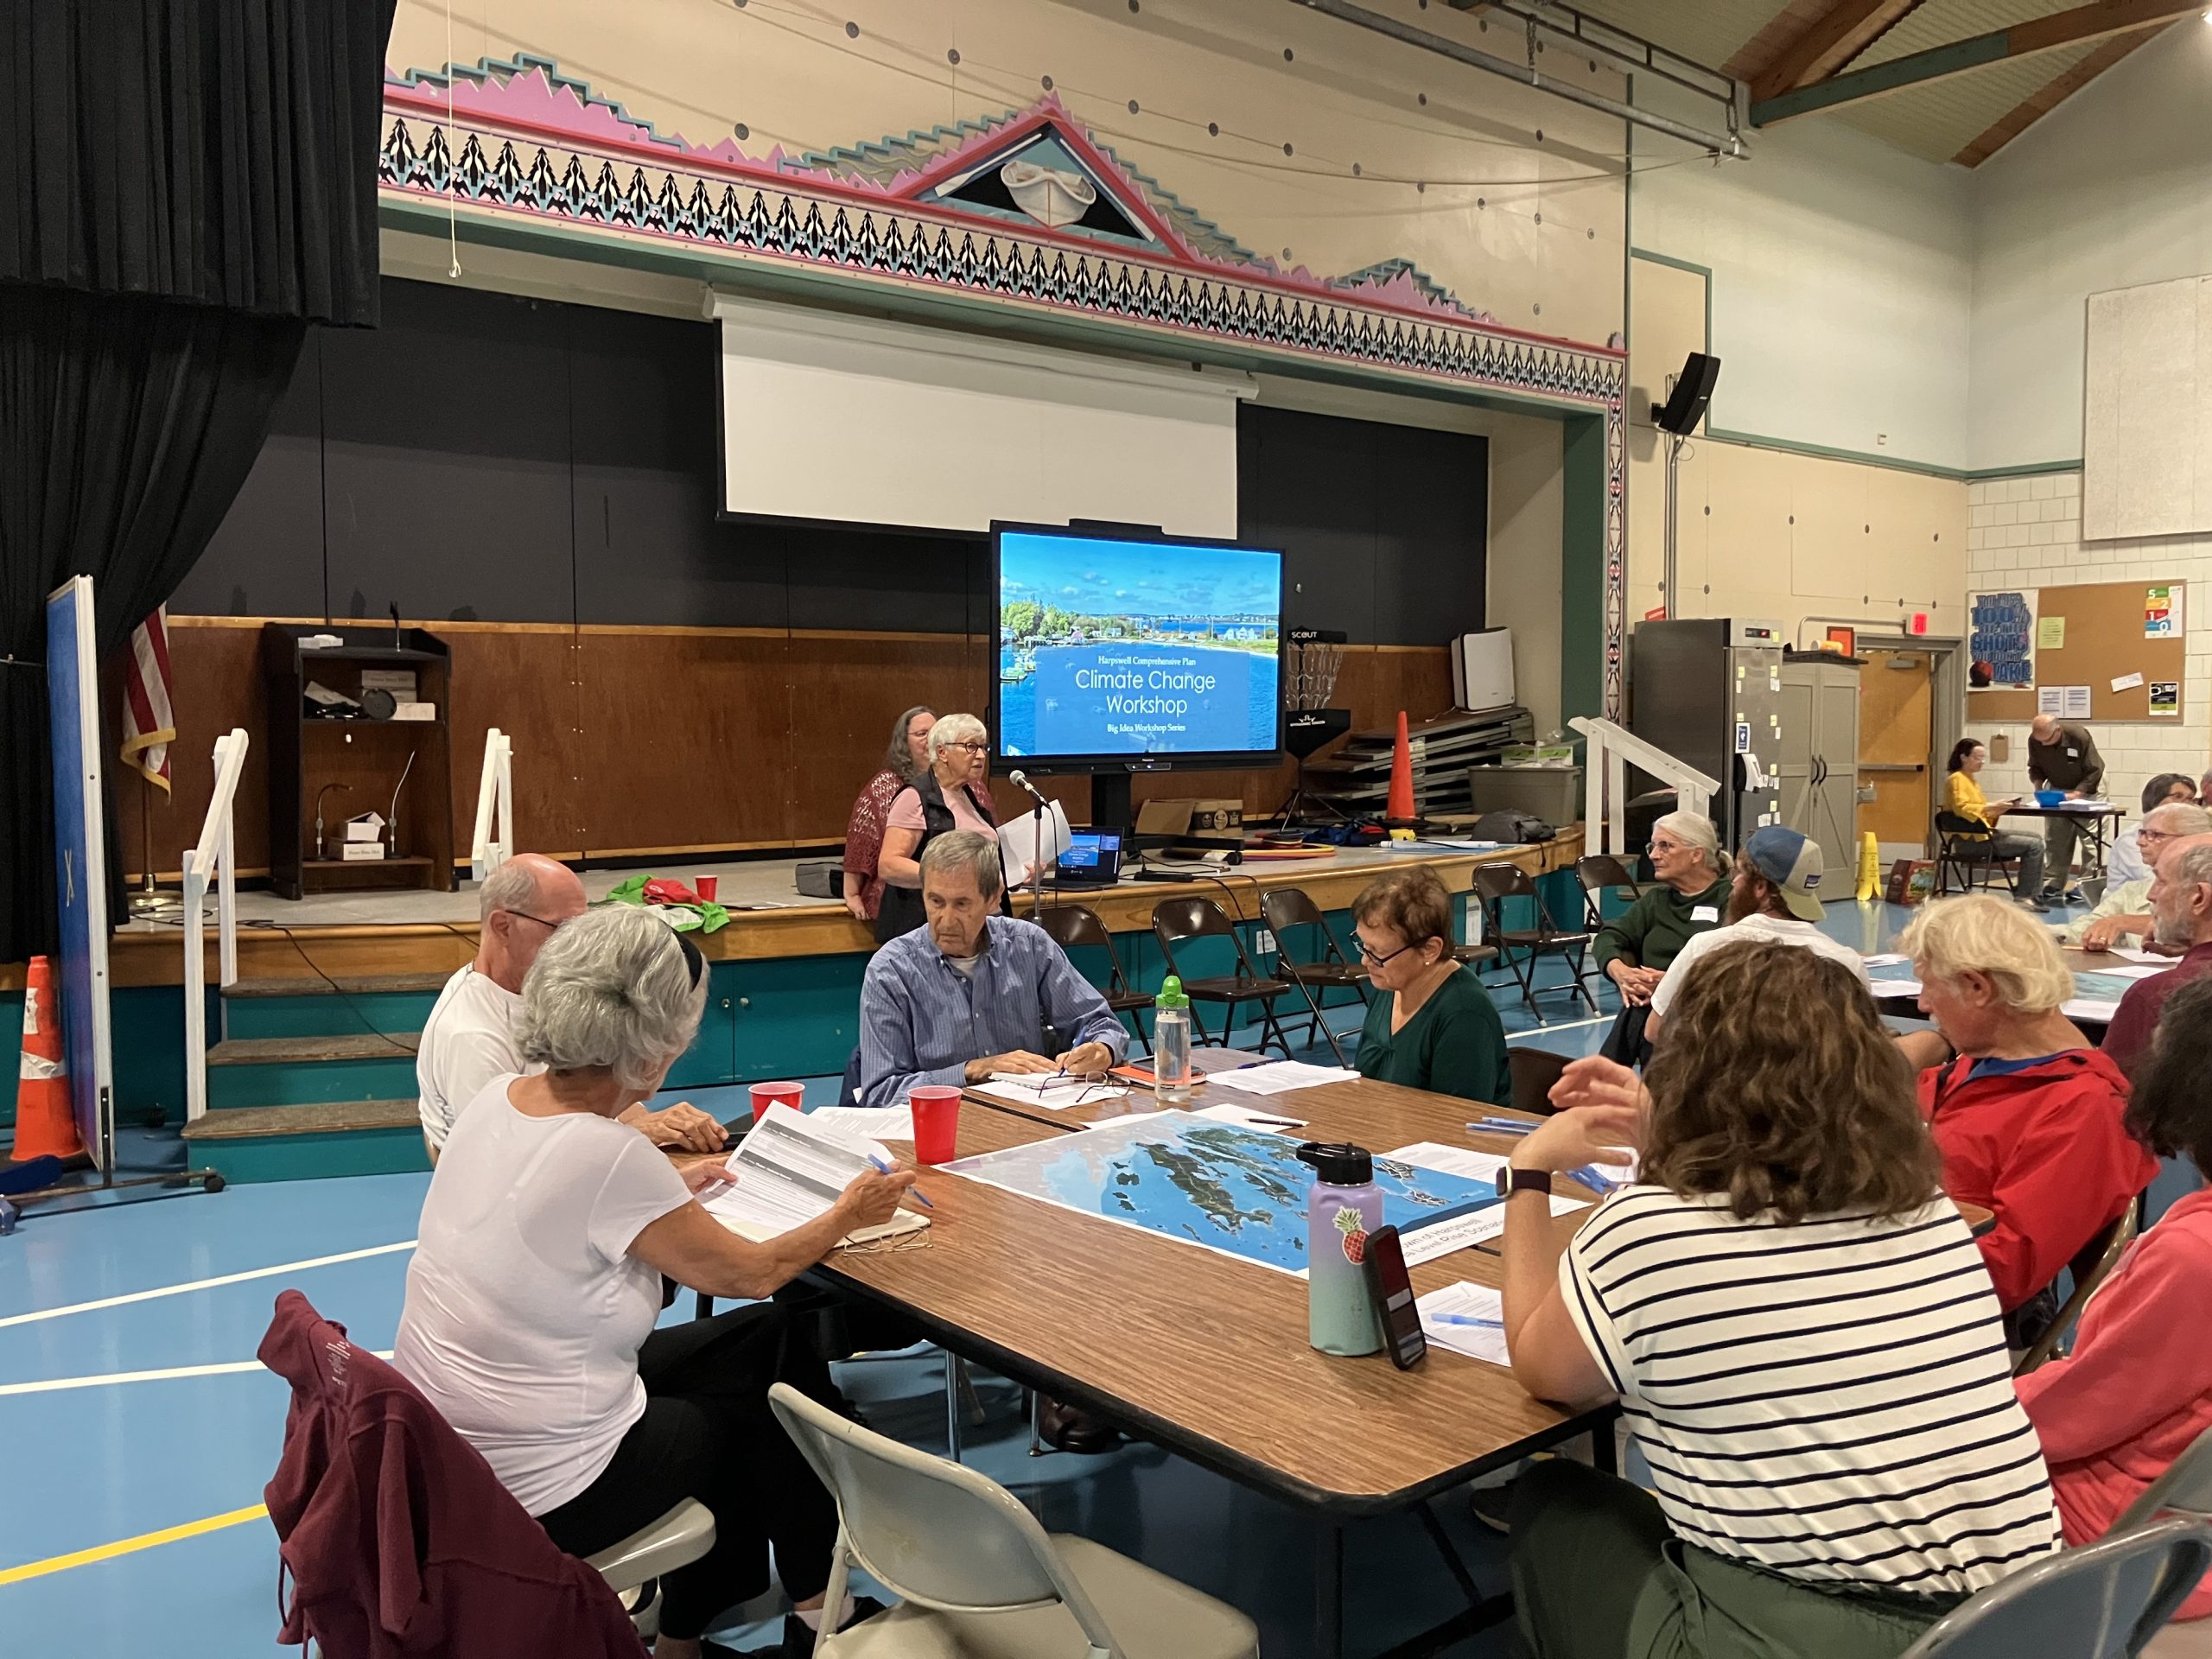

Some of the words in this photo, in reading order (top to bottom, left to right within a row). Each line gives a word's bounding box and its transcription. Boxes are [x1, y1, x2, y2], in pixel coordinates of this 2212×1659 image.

[2160, 600, 2169, 608] 2
[2148, 611, 2155, 621] 1
[2159, 621, 2169, 632] 0
[1098, 656, 1131, 667] Harpswell
[1132, 657, 1181, 667] Comprehensive
[1182, 658, 1197, 666] Plan
[1076, 670, 1144, 690] Climate
[1148, 671, 1217, 694] Change
[1106, 696, 1188, 718] Workshop
[1107, 724, 1119, 734] Big
[1135, 724, 1166, 734] Workshop
[1167, 723, 1186, 732] Series
